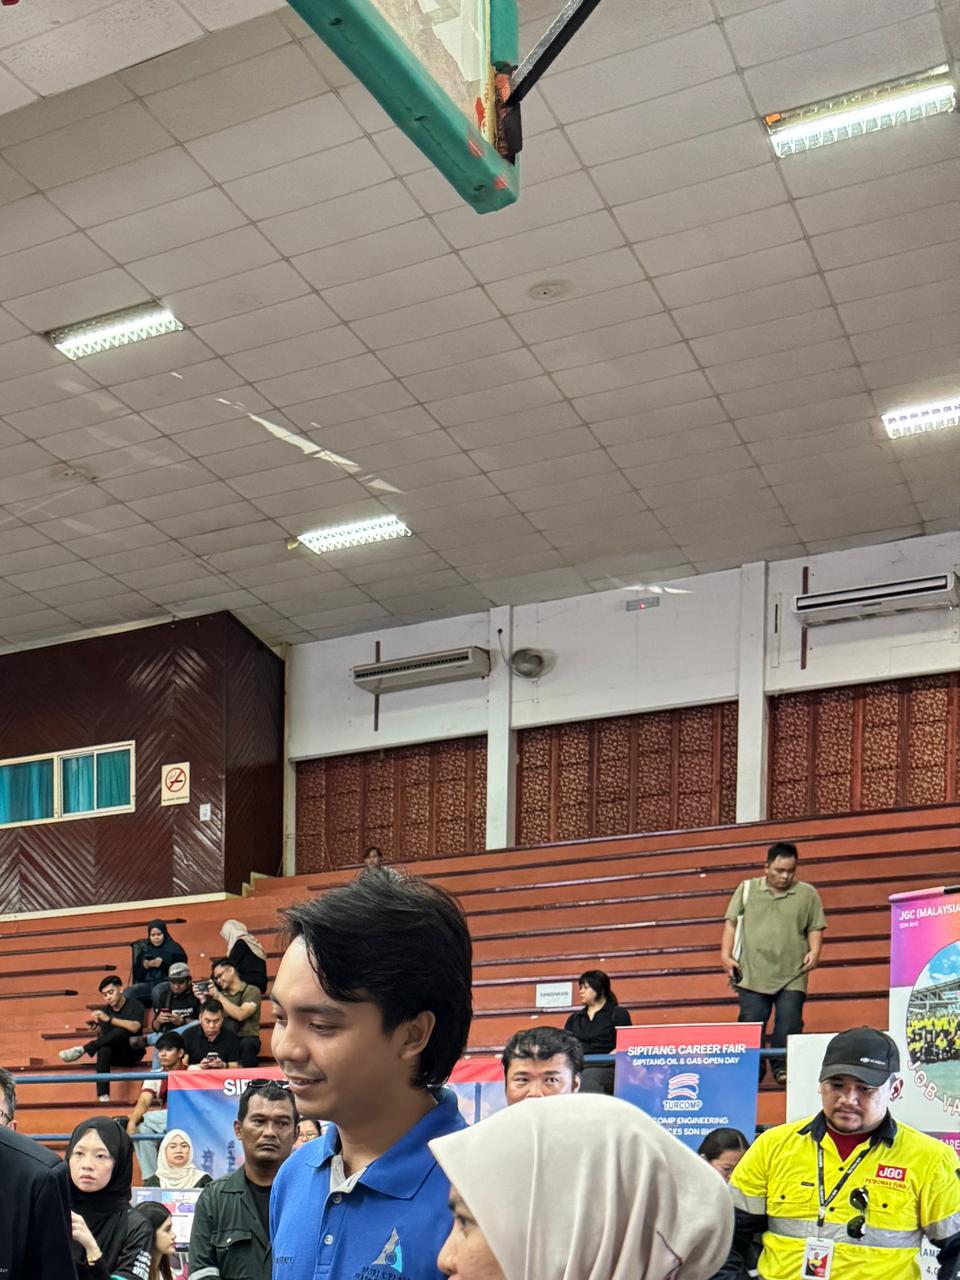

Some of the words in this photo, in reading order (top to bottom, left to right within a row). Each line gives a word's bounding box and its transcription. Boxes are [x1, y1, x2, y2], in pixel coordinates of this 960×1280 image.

[898, 909, 916, 921] JGC
[627, 1045, 676, 1056] SIPITANG
[678, 1044, 720, 1054] CAREER
[722, 1043, 746, 1054] FAIR
[632, 1058, 666, 1066] SIPITANG
[686, 1057, 702, 1065] GAS
[725, 1056, 740, 1064] DAY
[663, 1100, 702, 1111] TURCOMP
[676, 1116, 729, 1125] ENGINEERING
[879, 1167, 904, 1179] JGC
